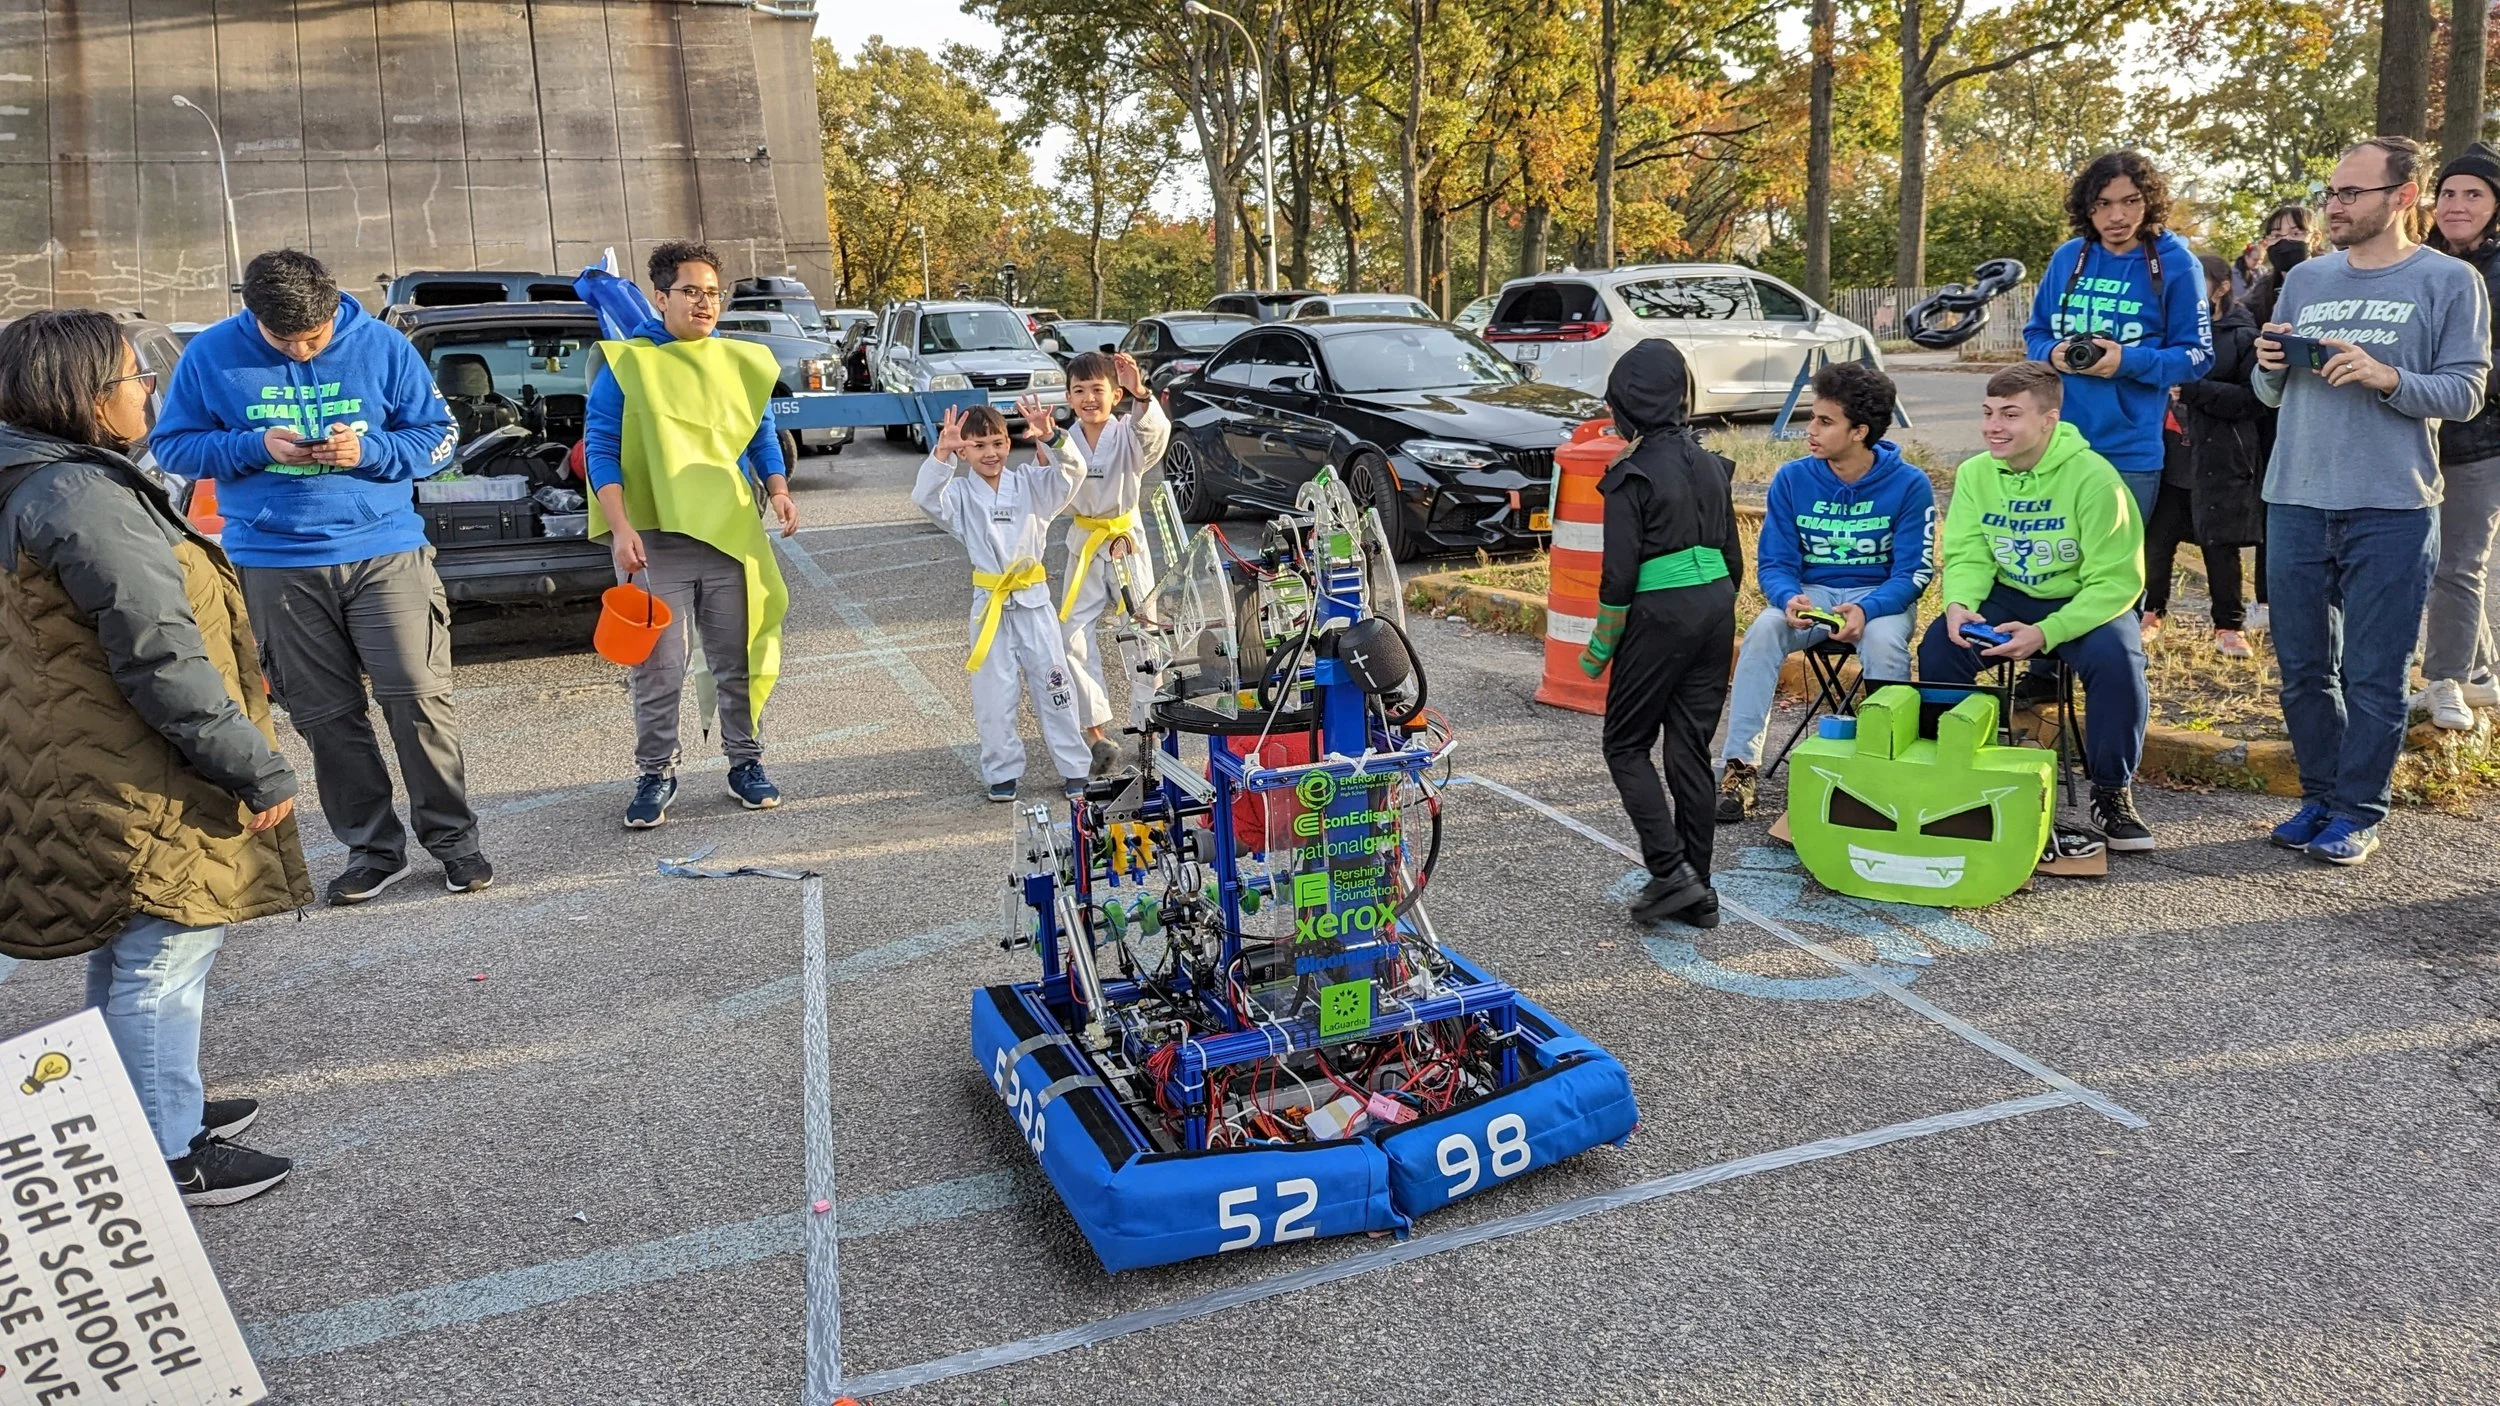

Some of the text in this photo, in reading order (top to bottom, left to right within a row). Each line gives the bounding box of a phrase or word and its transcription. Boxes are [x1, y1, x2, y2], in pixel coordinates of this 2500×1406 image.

[2149, 258, 2160, 274] EOS
[2297, 299, 2416, 327] ENERGY TECH
[2298, 325, 2399, 346] Chargers
[246, 398, 362, 420] CHARGERS
[1796, 514, 1891, 532] CHARGERS
[1982, 512, 2066, 532] CHRGERS
[1295, 829, 1400, 861] natonalgrid
[1333, 865, 1385, 881] Pershing
[1333, 878, 1376, 892] Square
[1333, 885, 1399, 903] Foundation
[1295, 900, 1397, 944] xerox
[1324, 1018, 1366, 1032] LaGuardia
[1218, 1113, 1531, 1252] 52 98
[51, 1114, 202, 1377] ENERGY TECH
[0, 1134, 138, 1392] HIGH SCHOOL
